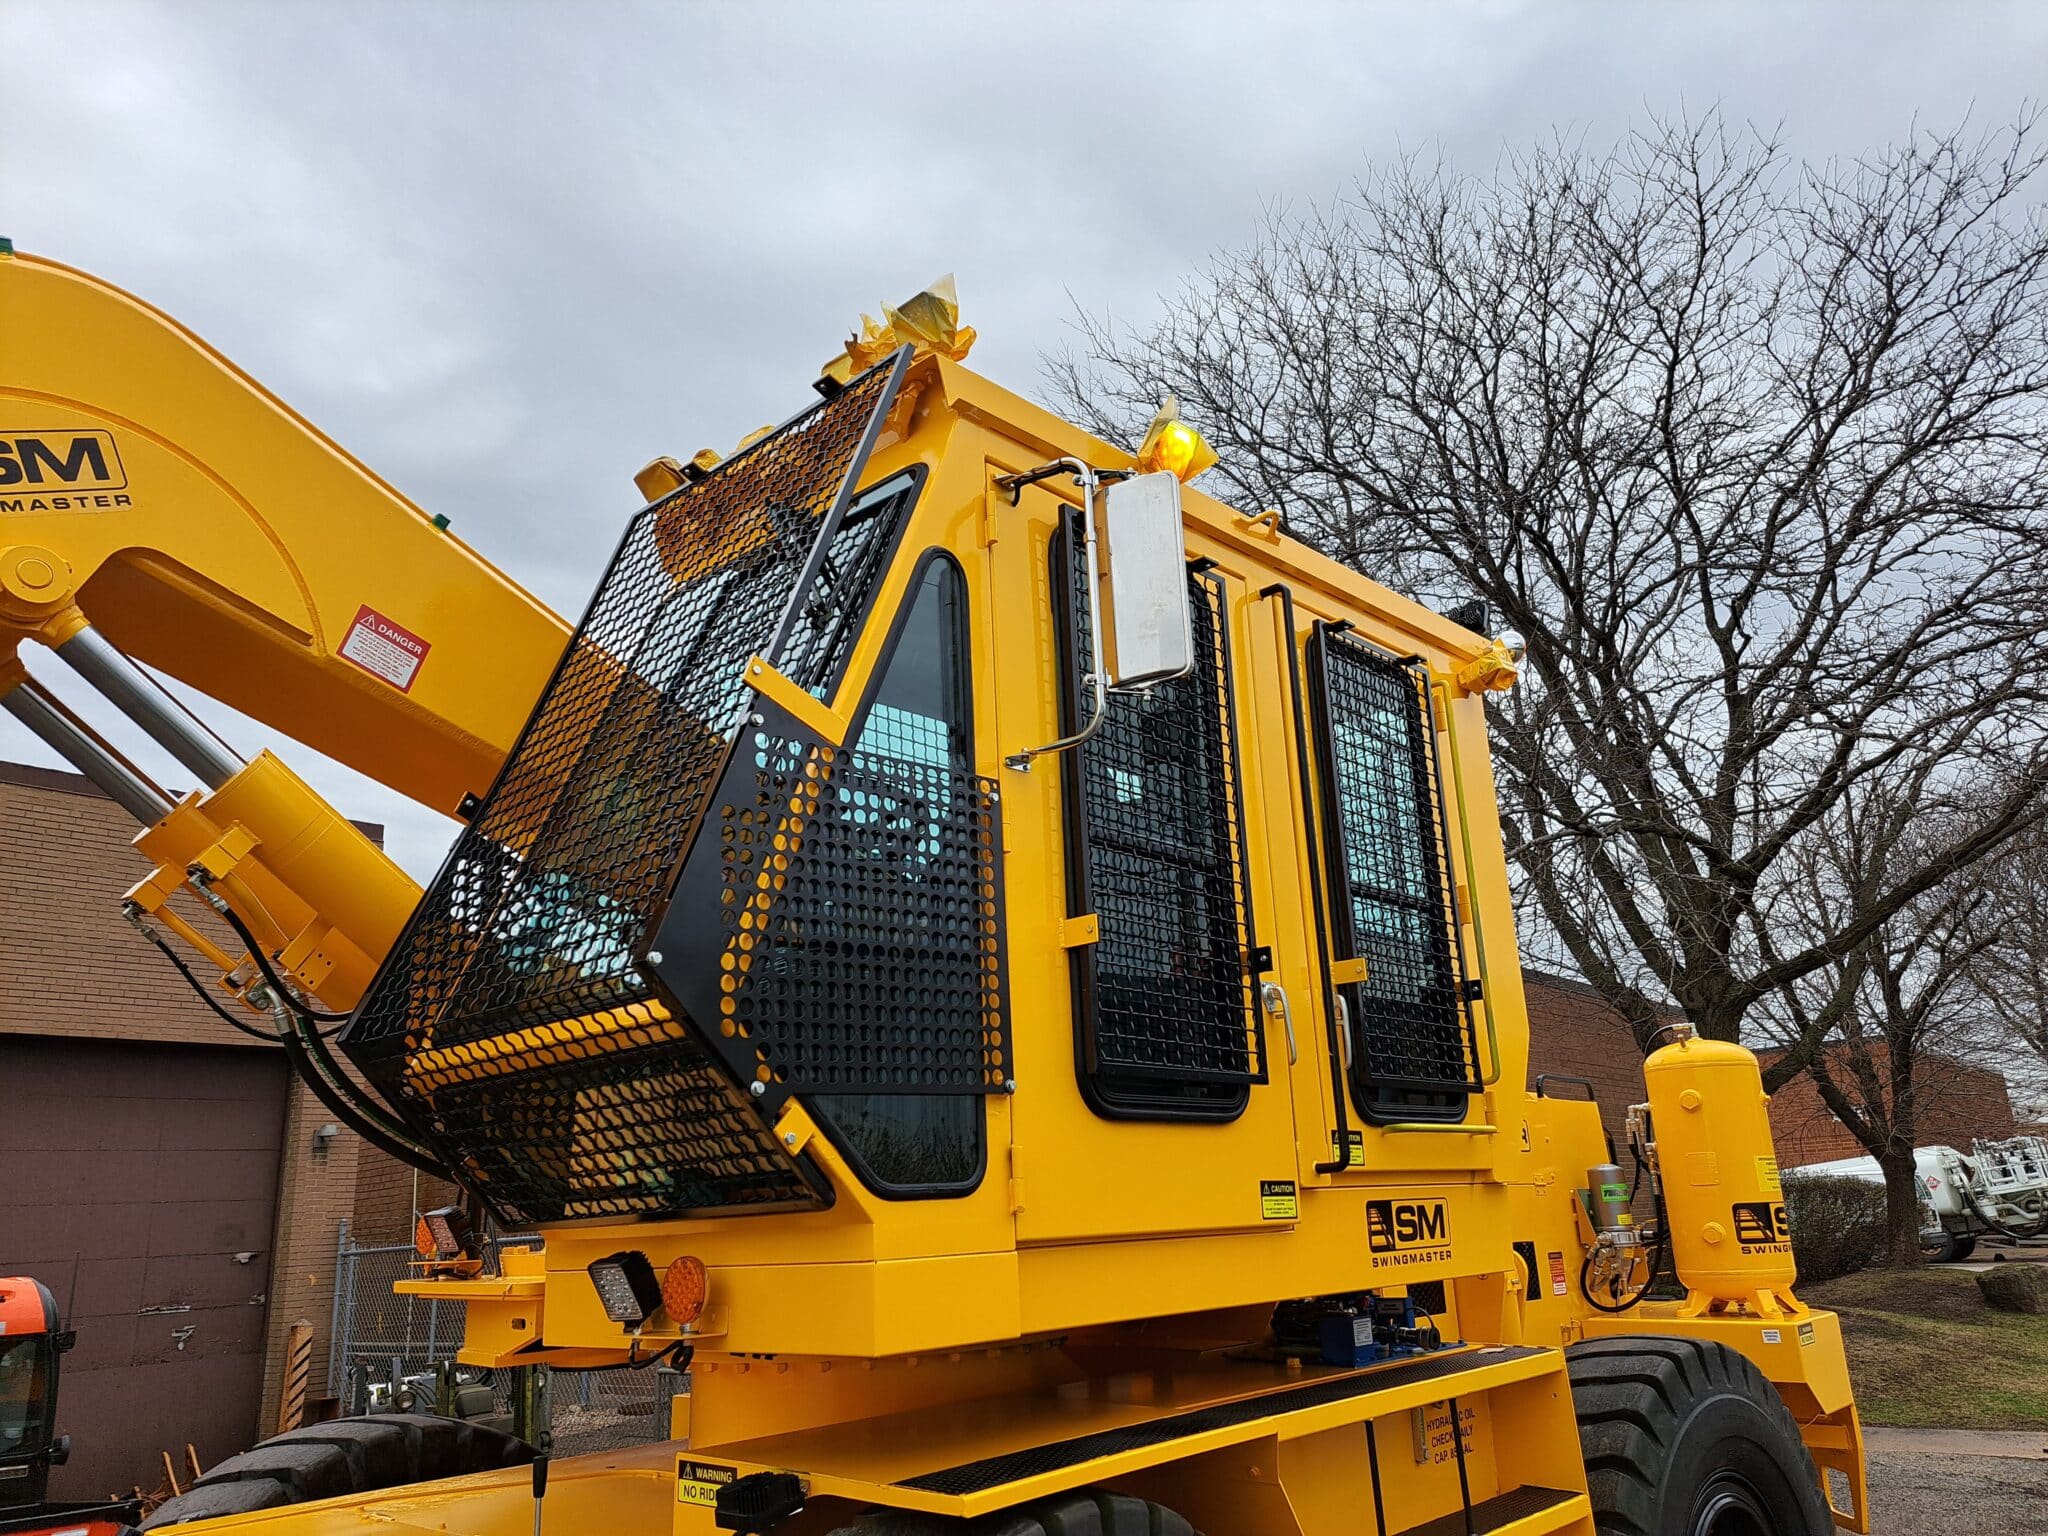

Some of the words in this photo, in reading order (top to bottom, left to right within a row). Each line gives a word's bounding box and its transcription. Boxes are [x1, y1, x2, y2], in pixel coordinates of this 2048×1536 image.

[378, 624, 423, 655] DANGER
[1270, 1184, 1294, 1193] CAUTION
[1395, 1203, 1446, 1242] SM
[1372, 1250, 1452, 1268] SWINGMASTER
[1464, 1407, 1476, 1420] OIL
[1460, 1424, 1473, 1438] AILY
[695, 1467, 733, 1483] WARNING
[683, 1484, 697, 1498] NO
